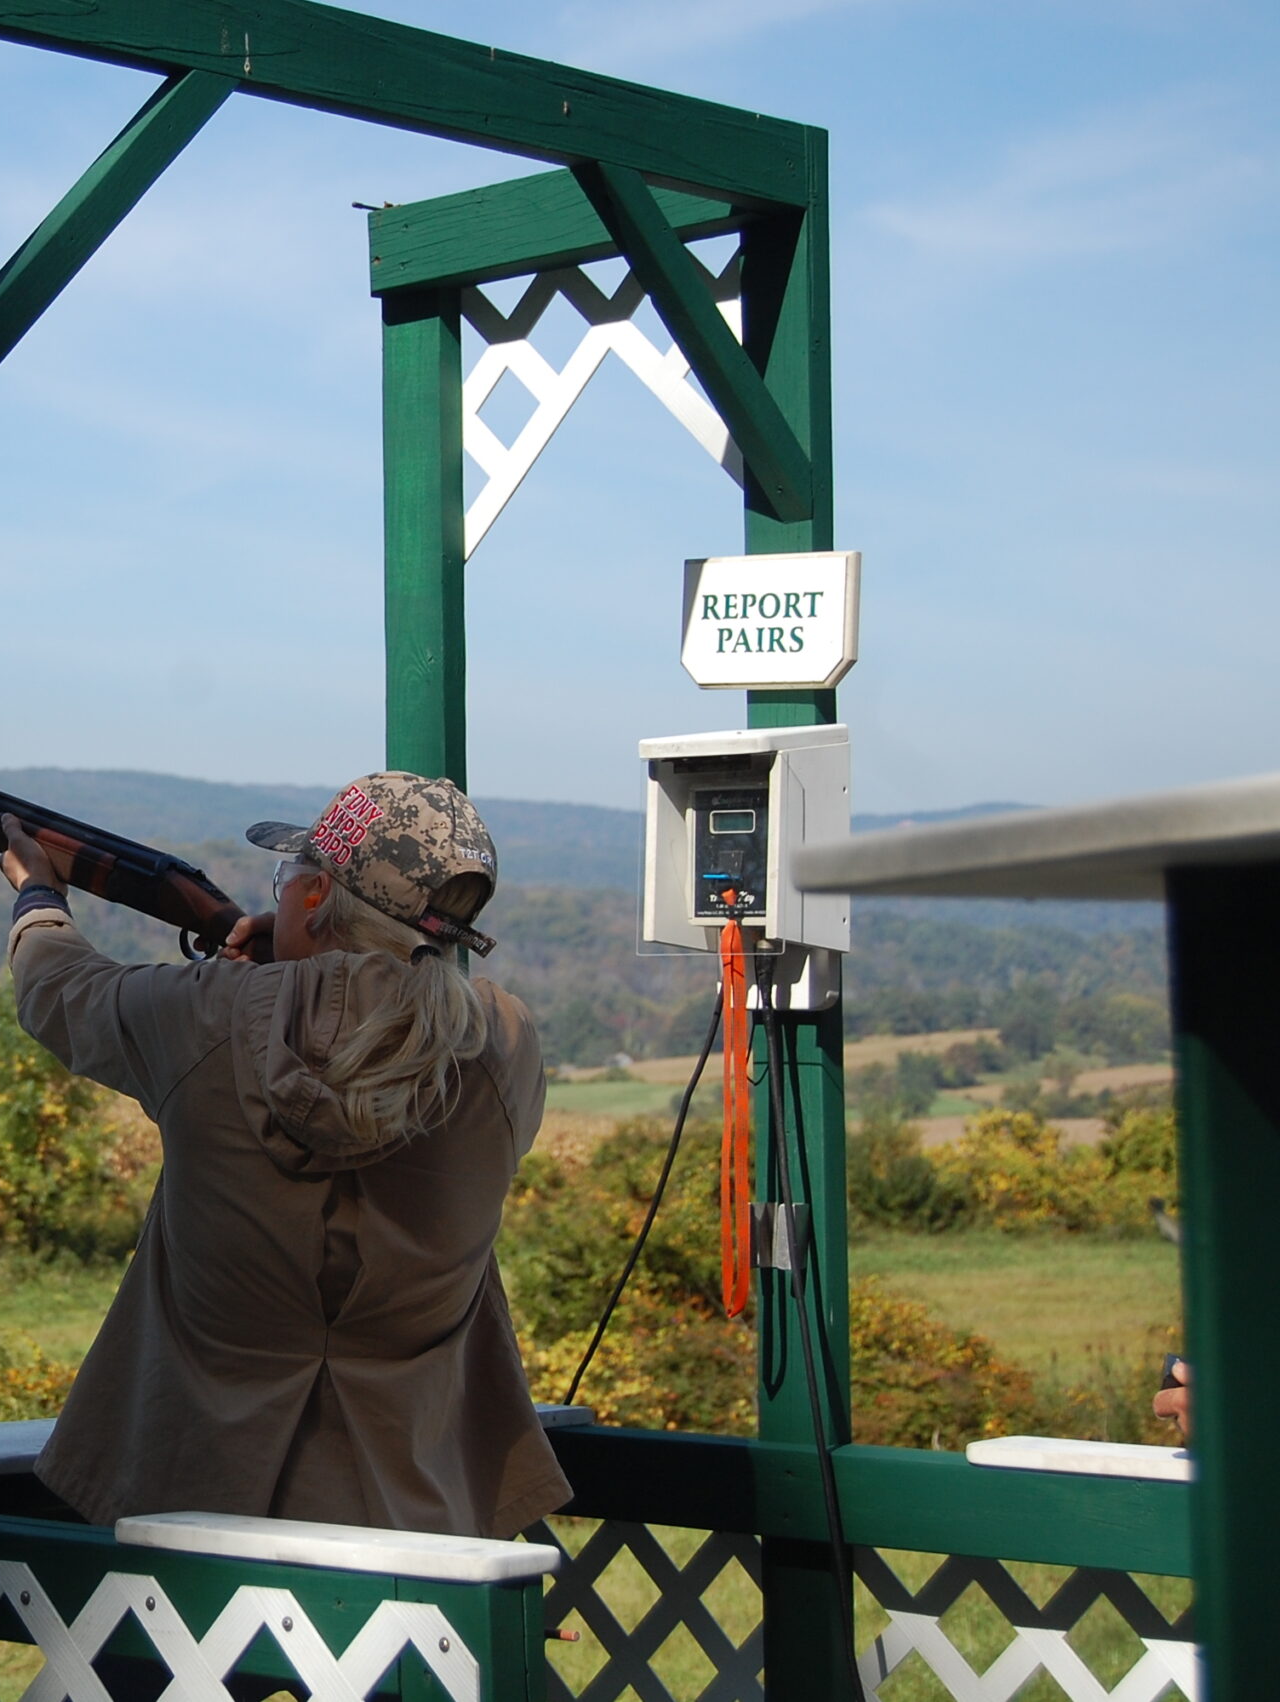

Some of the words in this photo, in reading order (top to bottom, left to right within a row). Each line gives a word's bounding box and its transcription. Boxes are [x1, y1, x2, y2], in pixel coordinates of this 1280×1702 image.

[701, 591, 824, 620] REPORT
[716, 626, 804, 653] PAIRS
[325, 803, 367, 846] NYPD
[340, 785, 384, 828] FDNY
[310, 822, 352, 866] PAPD
